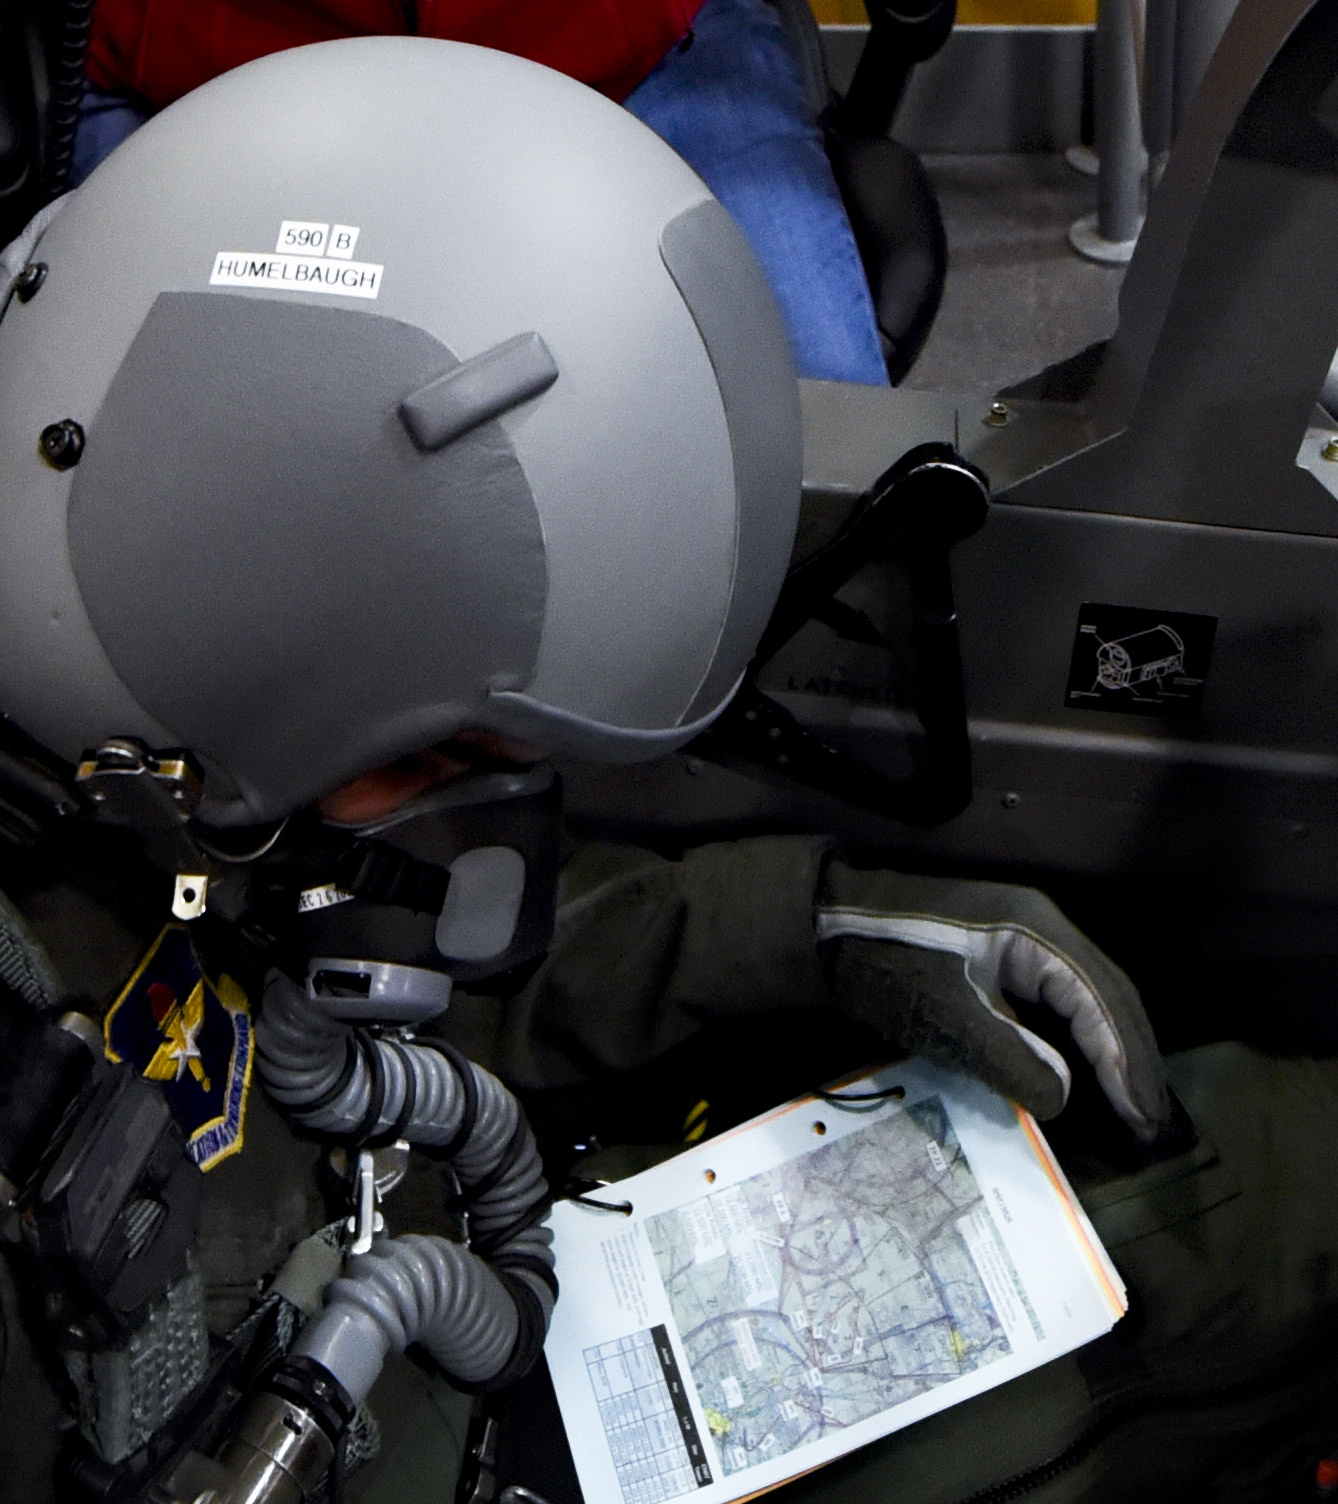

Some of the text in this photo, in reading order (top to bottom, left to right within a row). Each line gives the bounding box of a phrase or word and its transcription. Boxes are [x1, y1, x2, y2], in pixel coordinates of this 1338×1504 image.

[284, 228, 351, 250] 590 B
[217, 259, 376, 289] HUMELBAUGH
